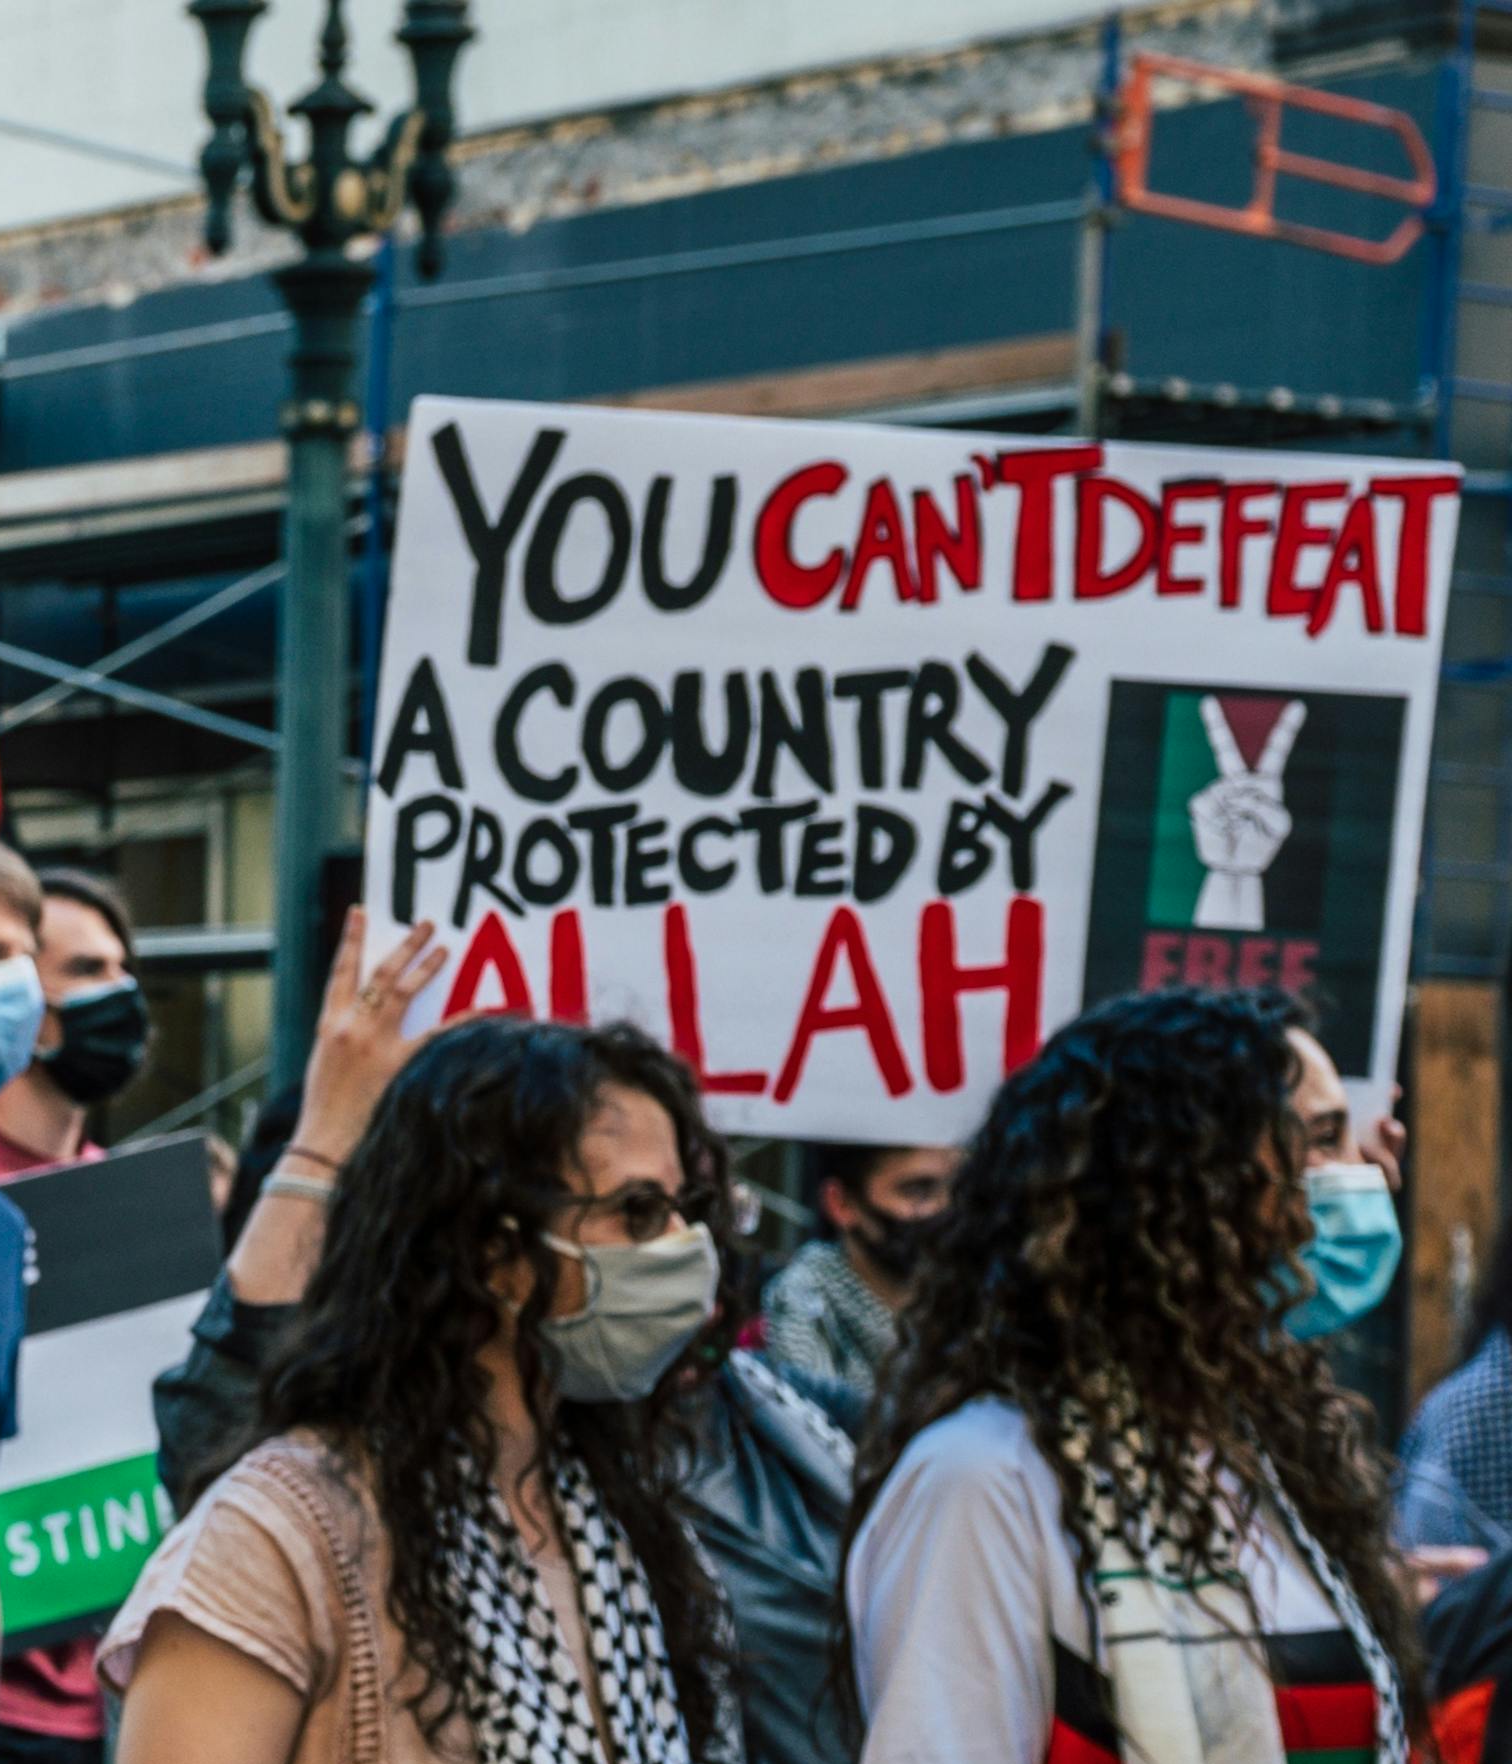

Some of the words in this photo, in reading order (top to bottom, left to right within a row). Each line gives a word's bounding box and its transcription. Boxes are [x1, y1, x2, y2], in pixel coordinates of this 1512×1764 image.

[430, 421, 740, 668] YOU
[752, 441, 1105, 611] CAN'T
[1074, 474, 1461, 639] DEFEAT
[376, 655, 465, 798] A
[493, 641, 1077, 803] COUNTRY
[392, 794, 919, 930] PROTECTED
[937, 779, 1074, 898] BY
[440, 893, 1045, 1106] ALLAH
[1139, 932, 1322, 995] FREE
